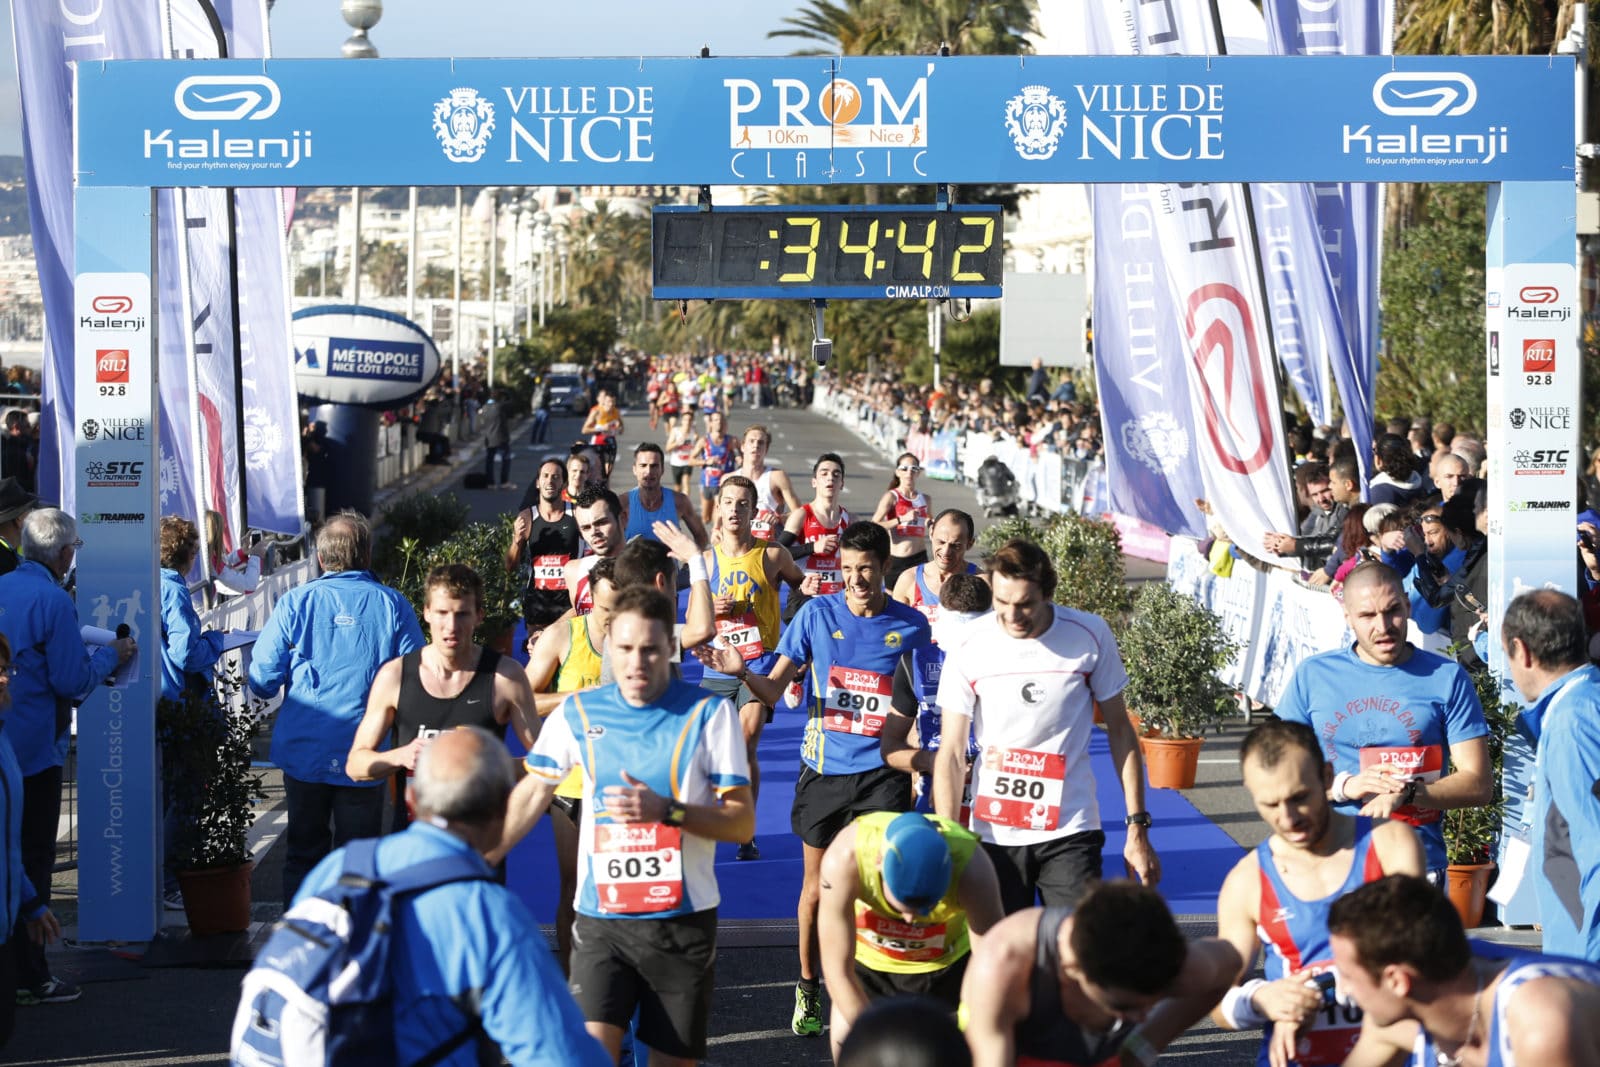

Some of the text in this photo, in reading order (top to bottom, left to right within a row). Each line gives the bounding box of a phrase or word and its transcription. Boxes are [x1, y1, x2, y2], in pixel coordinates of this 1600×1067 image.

[501, 86, 654, 114] VILLE DE
[1073, 84, 1224, 112] VILLE DE
[505, 116, 654, 163] NICE
[767, 129, 808, 144] 10Km
[869, 129, 904, 143] Nice
[1077, 113, 1225, 160] NICE
[144, 129, 311, 168] Kalenji
[1343, 124, 1508, 164] Kalenji
[167, 161, 182, 169] find
[183, 162, 200, 170] your
[201, 161, 228, 170] rhythm
[229, 162, 250, 170] enjoy
[251, 162, 268, 170] your
[1366, 156, 1380, 164] find
[1381, 157, 1398, 165] your
[1399, 156, 1425, 165] rhythm
[1426, 157, 1447, 165] enjoy
[1448, 157, 1464, 165] your
[885, 285, 951, 298] CIMALP.COM
[1507, 306, 1571, 321] Kalenji
[80, 316, 145, 332] Kalenji
[333, 345, 420, 367] MÉTROPOLE
[1526, 348, 1553, 361] RTL2
[98, 359, 127, 372] RTL2
[332, 362, 418, 377] NICE CÔTE D'AZUR
[1526, 375, 1552, 385] 92.8
[1528, 407, 1570, 415] VILLE DE
[101, 418, 144, 426] VILLE DE
[1529, 416, 1570, 429] NICE
[103, 427, 145, 440] NICE
[1532, 450, 1570, 463] STC
[104, 461, 144, 474] STC
[837, 692, 879, 712] 890
[101, 687, 123, 896] www.PromClassic.co
[994, 776, 1045, 800] 580
[608, 856, 661, 879] 603
